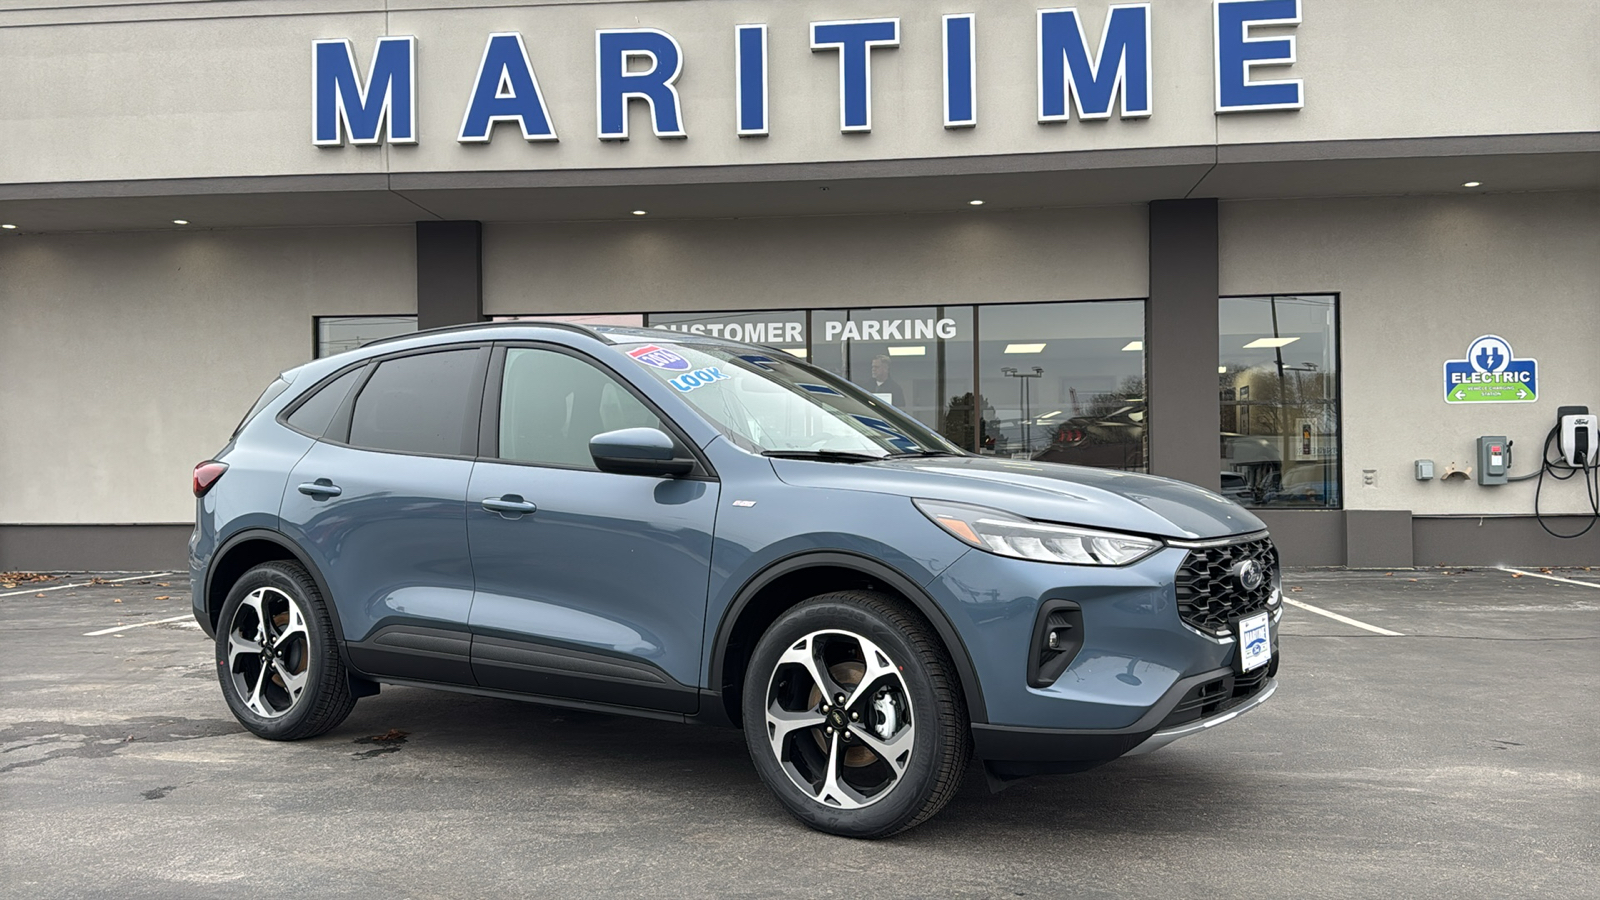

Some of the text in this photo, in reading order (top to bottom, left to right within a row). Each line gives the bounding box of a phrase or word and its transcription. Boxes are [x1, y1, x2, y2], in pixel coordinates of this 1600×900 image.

[311, 0, 1304, 147] MARITIME
[653, 318, 957, 343] STOMER PARKING
[668, 366, 730, 392] LOOK
[1451, 371, 1531, 384] ELECTRIC
